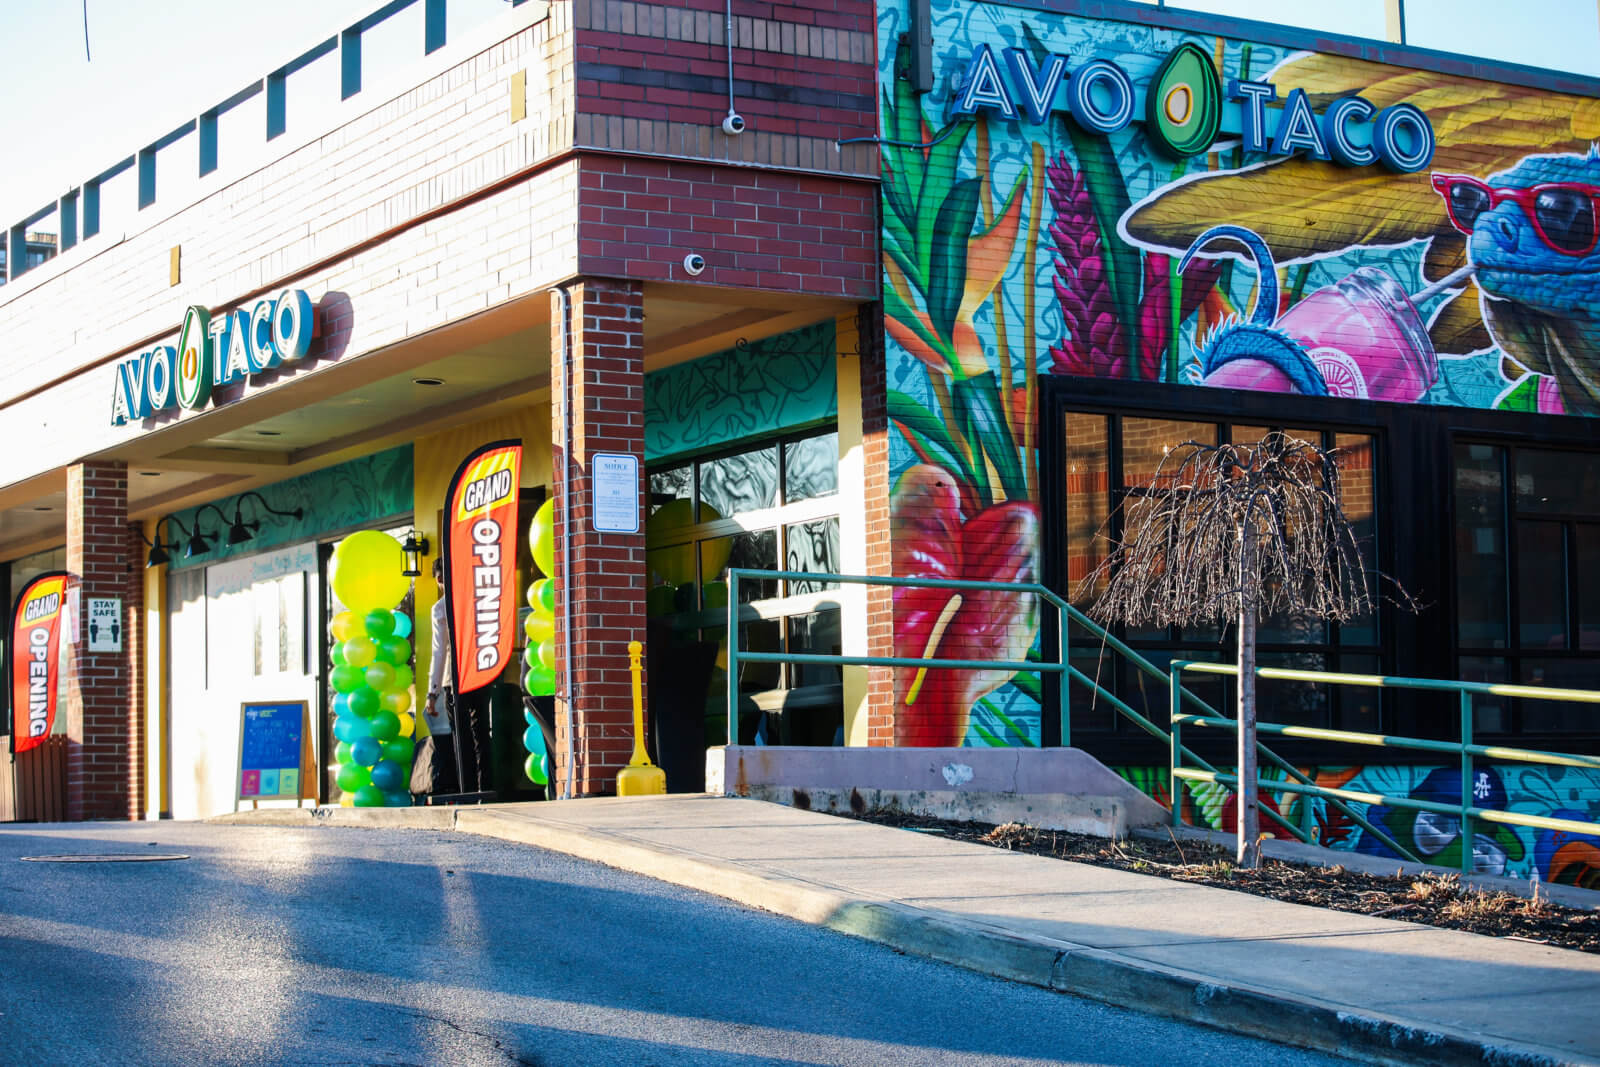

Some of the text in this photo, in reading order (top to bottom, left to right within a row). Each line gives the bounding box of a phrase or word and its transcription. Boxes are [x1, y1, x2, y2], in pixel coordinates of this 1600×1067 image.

[952, 43, 1435, 173] AVO TACO
[111, 289, 313, 426] AVO TACO
[465, 468, 512, 512] GRAND
[25, 592, 59, 622] GRAND
[93, 600, 116, 608] STAY
[93, 609, 116, 617] SAFE
[472, 518, 502, 672] OPENING
[29, 627, 50, 738] OPENING
